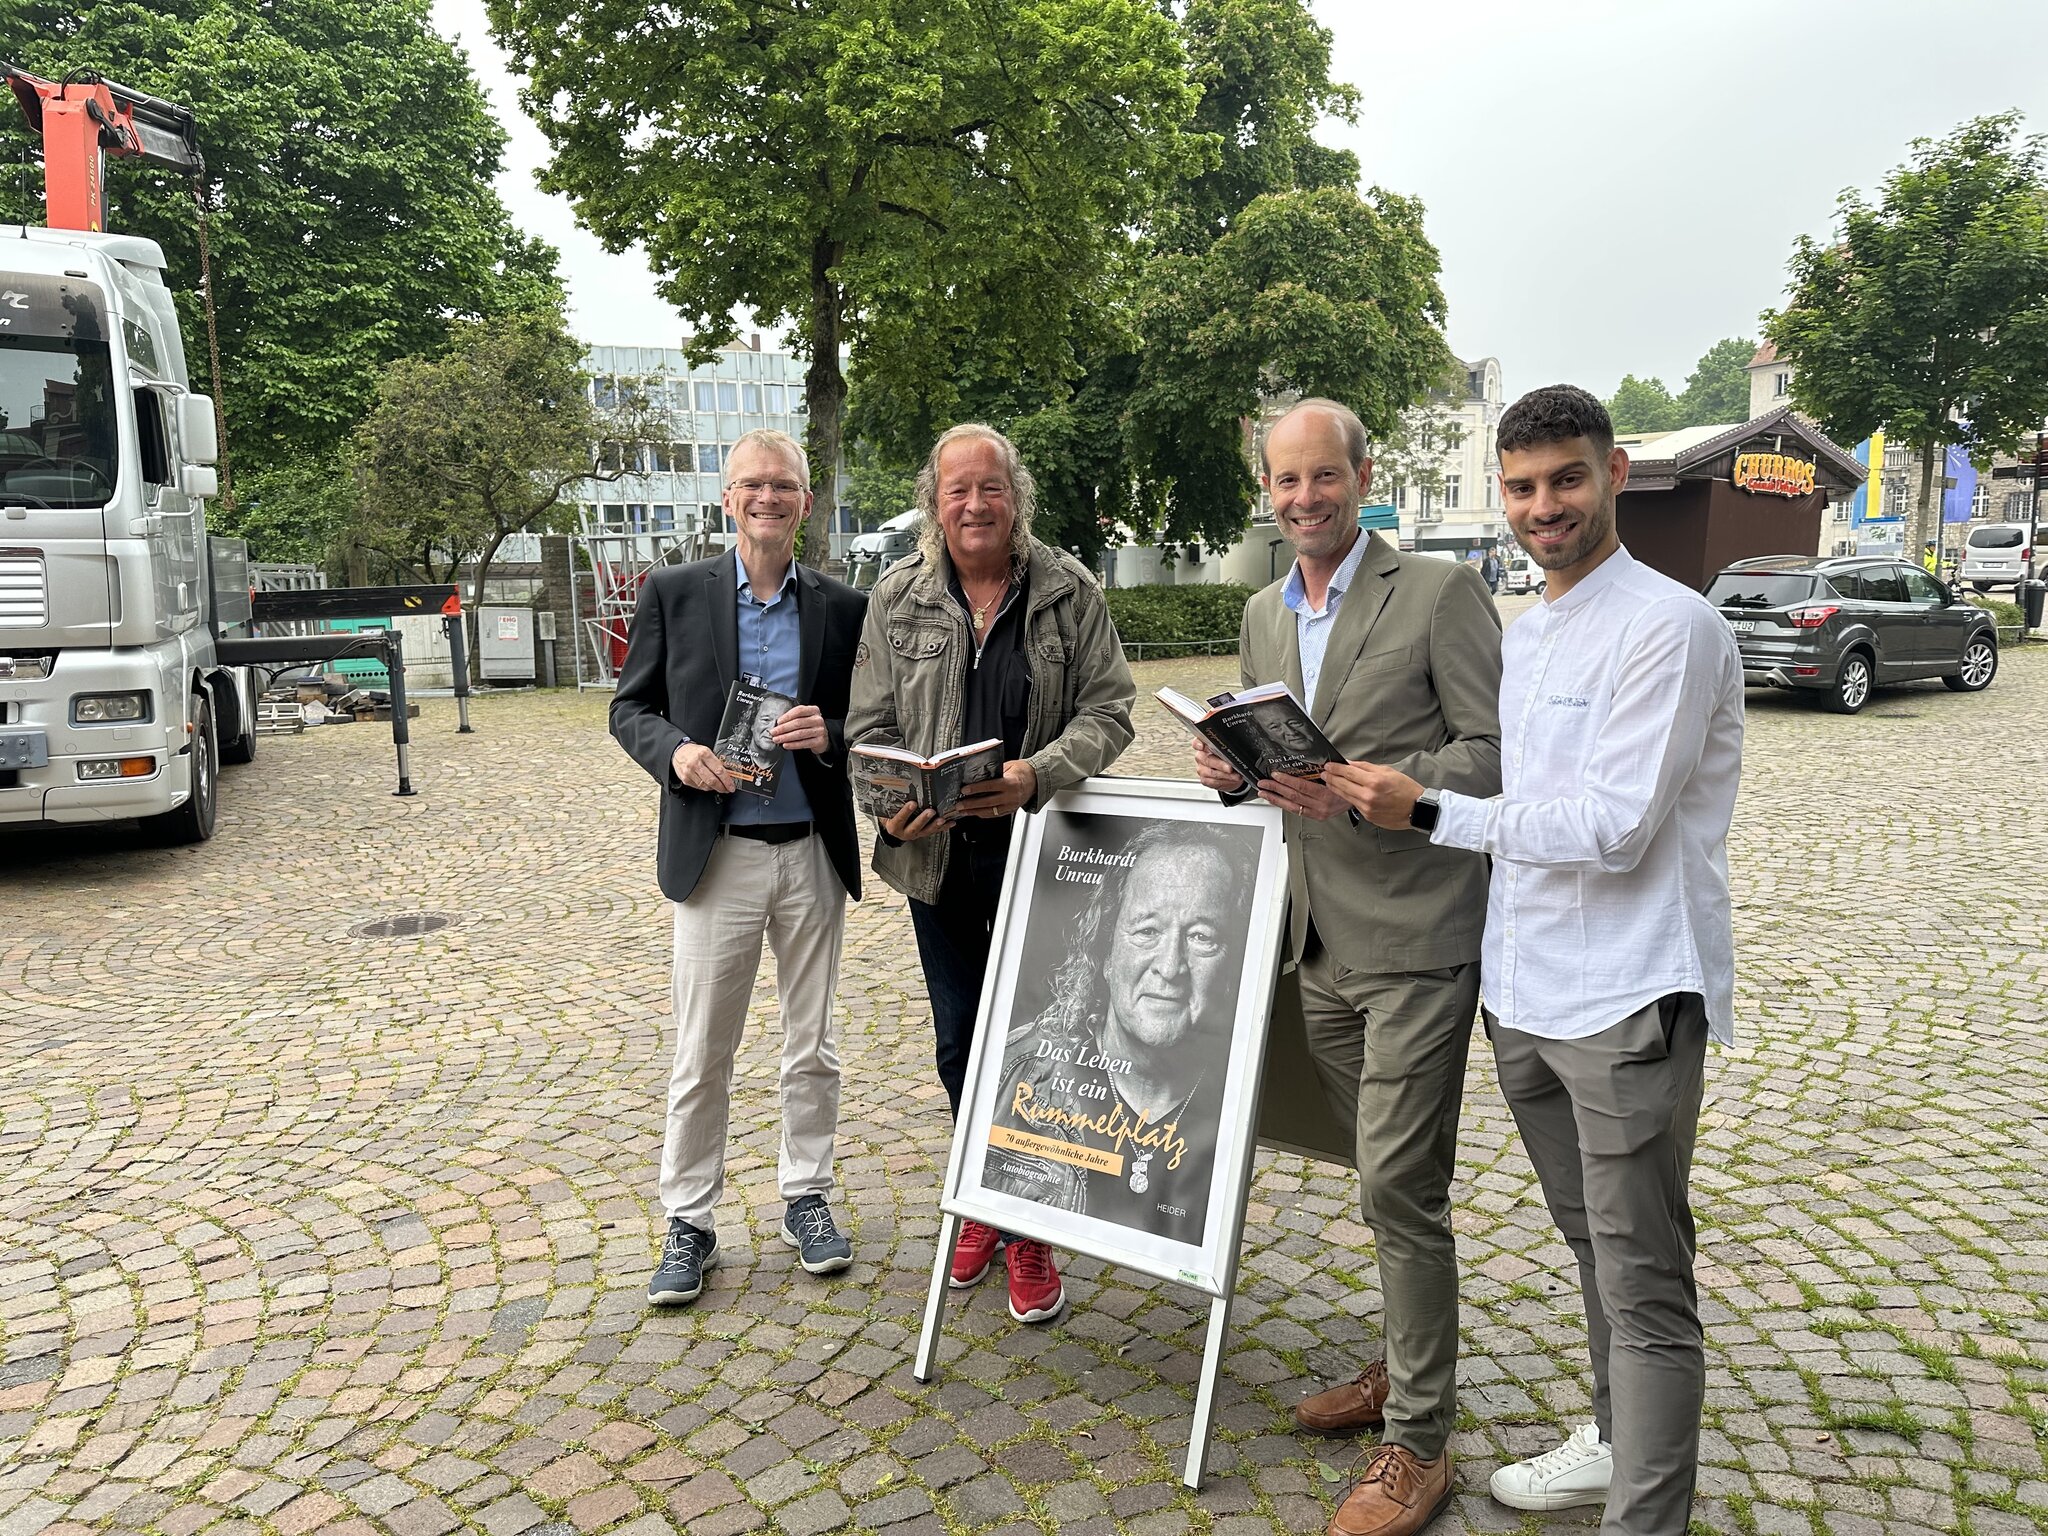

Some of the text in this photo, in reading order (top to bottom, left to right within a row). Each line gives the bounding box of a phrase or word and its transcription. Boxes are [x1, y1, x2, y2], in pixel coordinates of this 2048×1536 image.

[1734, 453, 1816, 495] CHURROS
[727, 744, 760, 758] Das Leben
[1283, 754, 1306, 762] Leben
[1057, 845, 1137, 868] Burkhardt
[1055, 864, 1103, 885] Unrau
[1035, 1038, 1133, 1075] Das Leben
[1051, 1071, 1108, 1101] ist ein
[1011, 1081, 1189, 1171] Rummelplatz
[1005, 1133, 1109, 1167] 70 außergewöhnliche Jahre
[999, 1161, 1061, 1185] Autobiographie
[1156, 1202, 1187, 1218] HEIDER
